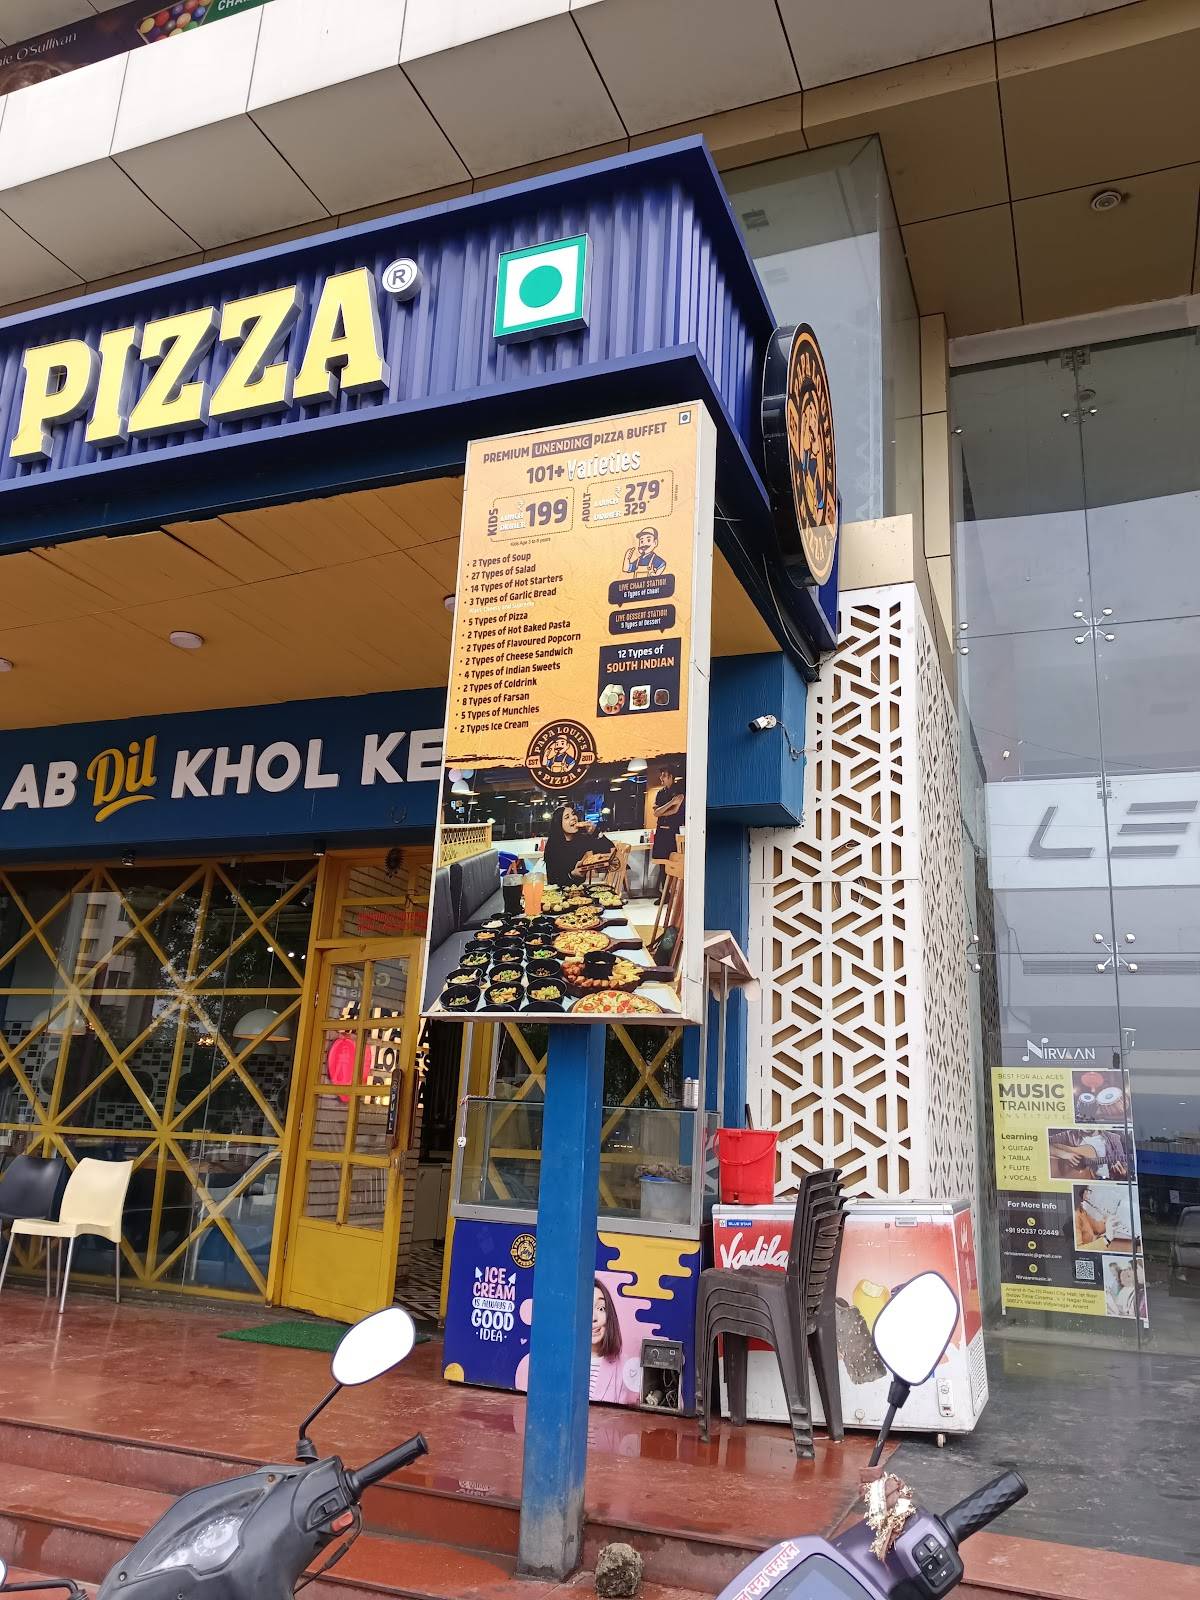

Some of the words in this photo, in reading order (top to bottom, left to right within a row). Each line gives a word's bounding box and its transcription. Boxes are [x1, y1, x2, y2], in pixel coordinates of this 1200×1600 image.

[16, 33, 77, 60] O'Sullivan
[9, 266, 389, 461] PIZZA
[483, 447, 530, 463] PREMIUM
[535, 436, 590, 455] UNENDING
[593, 430, 624, 445] PIZZA
[626, 422, 667, 440] BUFFET
[527, 464, 565, 484] 101+
[567, 450, 641, 481] Varieties
[582, 493, 591, 522] ADULT
[487, 508, 499, 537] KIDS
[478, 557, 501, 568] Types
[502, 554, 511, 563] of
[512, 553, 532, 562] Soup
[482, 570, 504, 580] Types
[505, 566, 514, 576] of
[515, 564, 536, 575] Salad
[471, 585, 479, 593] 14
[480, 582, 503, 593] Types
[504, 579, 514, 588] of
[514, 578, 528, 587] Hot
[530, 574, 564, 585] Starters
[469, 598, 474, 606] 3
[475, 595, 498, 606] Types
[499, 593, 508, 602] of
[509, 590, 532, 601] Garlic
[533, 587, 557, 598] Bread
[468, 618, 473, 626] 5
[474, 615, 497, 627] Types
[498, 613, 507, 622] of
[508, 612, 528, 622] Pizza
[467, 631, 472, 639] 2
[473, 628, 496, 640] Types
[497, 626, 507, 635] of
[507, 625, 522, 635] Hot
[523, 621, 547, 632] Baked
[548, 619, 571, 630] Pasta
[473, 641, 495, 653] Types
[496, 639, 506, 649] of
[506, 635, 546, 648] Flavoured
[547, 633, 581, 644] Popcorn
[618, 650, 626, 658] 12
[628, 647, 653, 659] Types
[654, 644, 664, 654] of
[465, 658, 470, 666] 2
[472, 655, 494, 667] Types
[496, 653, 505, 662] of
[506, 650, 534, 661] Cheese
[535, 646, 573, 658] Sandwich
[606, 661, 638, 673] SOUTH
[640, 657, 675, 670] INDIAN
[464, 671, 469, 679] 4
[471, 669, 494, 680] Types
[495, 666, 504, 676] of
[505, 664, 530, 675] Indian
[532, 662, 561, 672] Sweets
[463, 684, 468, 693] 2
[469, 683, 492, 693] Types
[493, 680, 503, 690] of
[504, 677, 537, 689] Coldrink
[462, 697, 467, 706] 8
[469, 696, 492, 706] Types
[493, 693, 502, 703] of
[503, 692, 530, 702] Farsan
[461, 711, 466, 719] 5
[467, 709, 490, 720] Types
[491, 706, 501, 717] of
[502, 705, 540, 716] Munchies
[460, 725, 465, 733] 2
[466, 723, 489, 734] Types
[491, 722, 502, 730] Ice
[503, 720, 529, 729] Cream
[534, 730, 556, 753] PAPA
[557, 726, 588, 750] LOUIE'S
[2, 760, 77, 810] AB
[87, 735, 158, 808] Dil
[171, 738, 339, 798] KHOL
[360, 729, 444, 784] KE
[542, 772, 577, 785] PIZZA
[998, 1083, 1065, 1099] MUSIC
[999, 1100, 1066, 1112] TRAINING
[1001, 1132, 1038, 1142] Learning
[1041, 1202, 1057, 1210] Info
[720, 1232, 789, 1271] Vadila
[485, 1266, 507, 1285] ICE
[473, 1281, 516, 1301] CREAM
[474, 1298, 480, 1307] IS
[482, 1299, 506, 1310] ALWAYS
[507, 1302, 513, 1311] A
[471, 1308, 515, 1332] GOOD
[479, 1328, 503, 1343] IDEA
